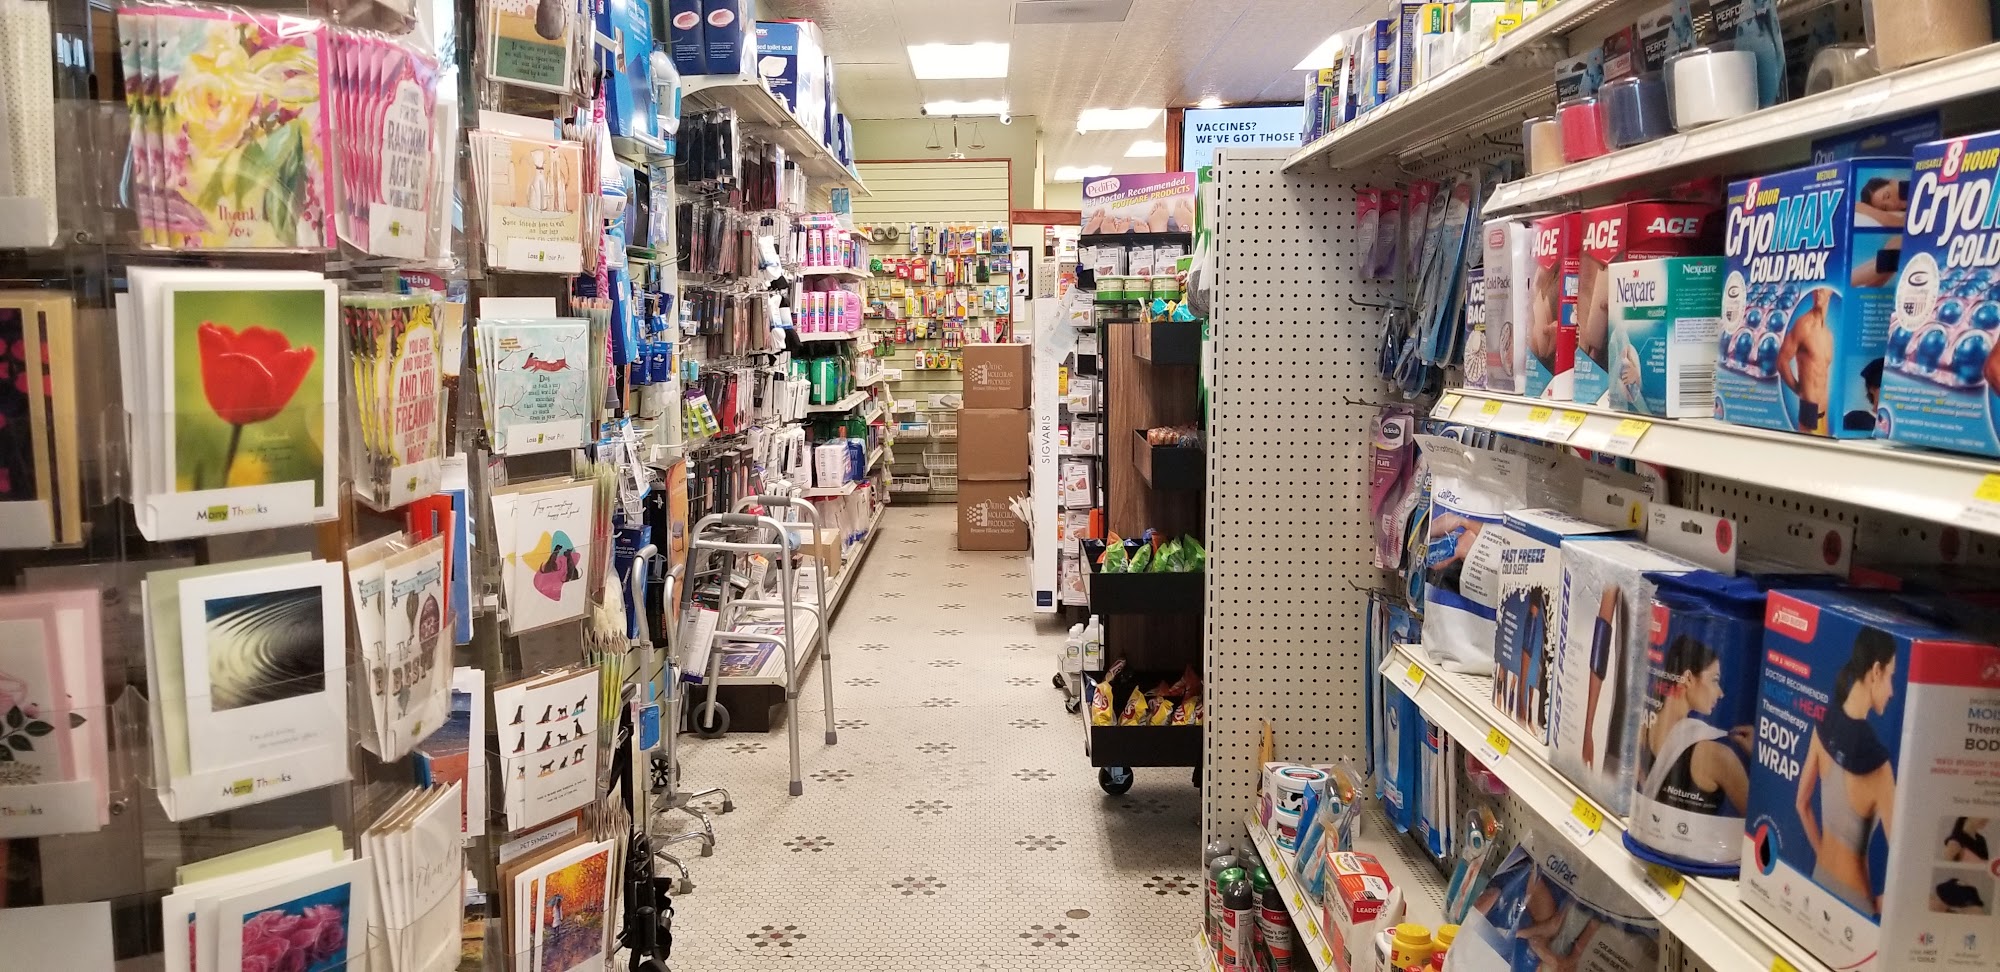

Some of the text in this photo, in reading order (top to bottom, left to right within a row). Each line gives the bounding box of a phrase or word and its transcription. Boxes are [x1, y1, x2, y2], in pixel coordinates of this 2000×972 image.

[387, 120, 426, 157] RANDOM
[1196, 122, 1257, 132] VACCINES?
[1196, 132, 1295, 144] WE'VE GOT THOSE
[1915, 156, 1943, 172] REUSABLE
[1943, 141, 1962, 177] 8
[1960, 148, 2000, 171] HOUR
[1088, 180, 1118, 195] PediFix
[1100, 192, 1125, 205] Doctor
[1128, 176, 1186, 198] Recommended
[1112, 184, 1190, 210] FOOTCARE PRODUCTS
[1746, 182, 1758, 210] 8
[1756, 188, 1780, 207] HOUR
[1582, 218, 1622, 251] ACE
[1646, 217, 1699, 234] ACE
[1726, 188, 1845, 266] CryoMAX
[1532, 227, 1560, 258] ACE
[1682, 264, 1716, 276] Nexcare
[1750, 252, 1830, 284] COLD PACK
[1470, 282, 1484, 301] ICE
[1486, 276, 1510, 289] Cold Pack
[1616, 278, 1656, 311] Nexcare
[1468, 304, 1486, 324] BAG
[399, 368, 434, 399] AND YOU
[1042, 415, 1050, 464] SIGVARIS
[1438, 488, 1461, 505] ColPac
[196, 504, 268, 522] Many Thanks
[1501, 548, 1546, 564] FAST FREEZE
[1502, 564, 1528, 576] COLD SLEEVE
[1552, 566, 1572, 750] FAST FREEZE
[1765, 668, 1829, 704] DOCTOR RECOMMENDED
[1759, 716, 1800, 756] BODY
[1758, 740, 1800, 782] WRAP
[222, 774, 292, 797] Many Thanks
[1, 806, 43, 816] Thanks
[1546, 854, 1579, 887] ColPac
